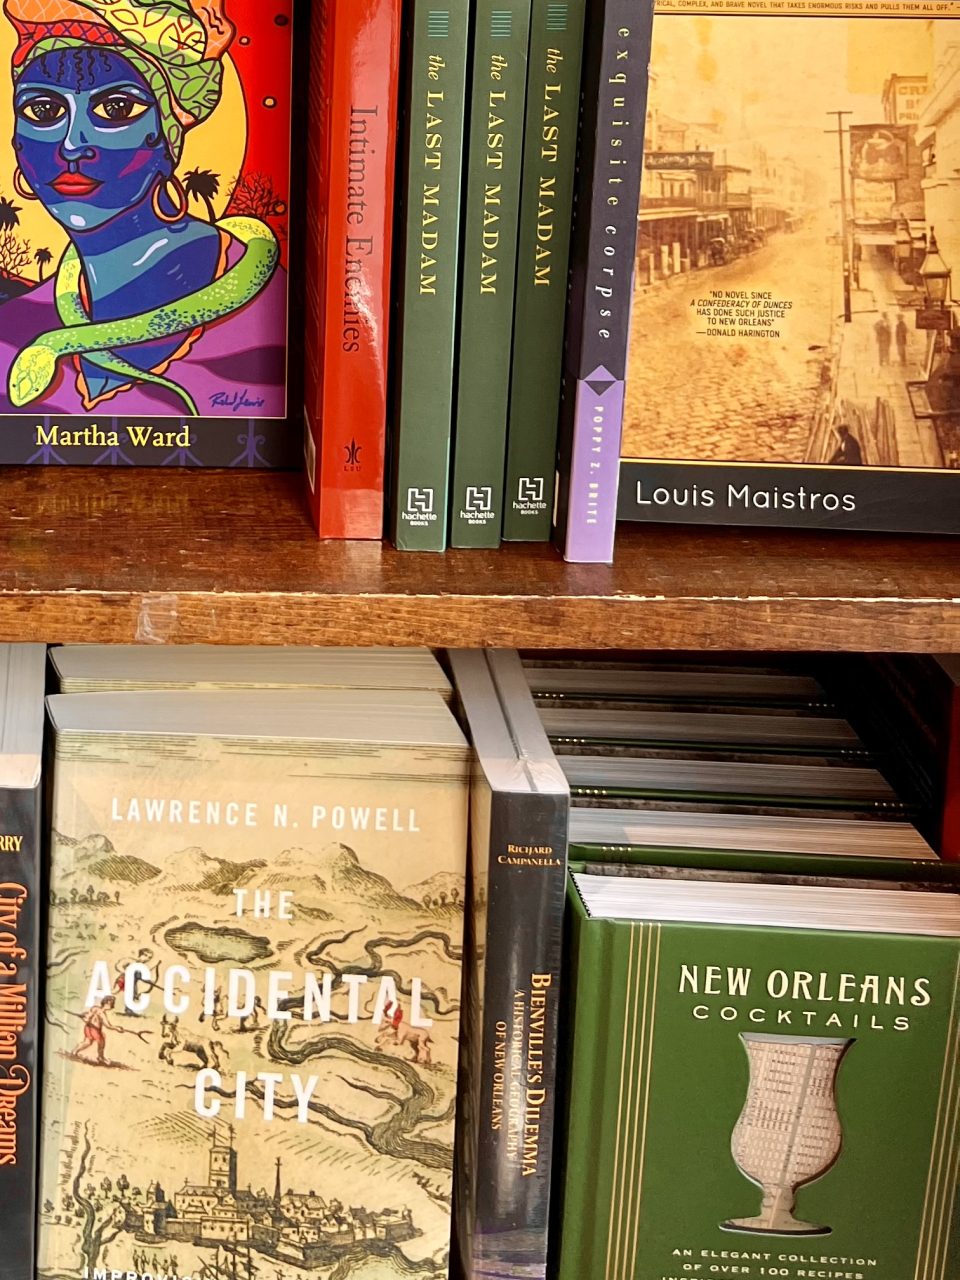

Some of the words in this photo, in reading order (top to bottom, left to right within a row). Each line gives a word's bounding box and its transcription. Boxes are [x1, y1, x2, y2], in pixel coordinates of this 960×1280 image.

[428, 54, 447, 81] the
[425, 91, 444, 170] LAST
[607, 28, 630, 206] exquisite
[419, 183, 440, 295] MADAM
[594, 225, 617, 339] corpse
[36, 425, 119, 446] Martha
[126, 426, 191, 447] Ward
[637, 481, 714, 507] Louis
[728, 485, 856, 511] Maistros
[402, 512, 437, 520] hachette
[112, 798, 257, 827] LAWRENCE
[274, 804, 299, 828] N.
[312, 806, 420, 832] POWELL
[498, 856, 560, 865] CAMPANELLA
[508, 845, 552, 854] RICHARD
[233, 889, 294, 919] THE
[85, 960, 433, 1026] ACCIDENTAL
[679, 965, 751, 996] NEW
[767, 970, 931, 1006] ORLEANS
[693, 1006, 909, 1030] COCKTAILS
[194, 1068, 318, 1122] CITY
[522, 1087, 546, 1176] DILEMMA
[701, 1250, 771, 1261] ELEGANT
[778, 1254, 877, 1265] COLLECTION
